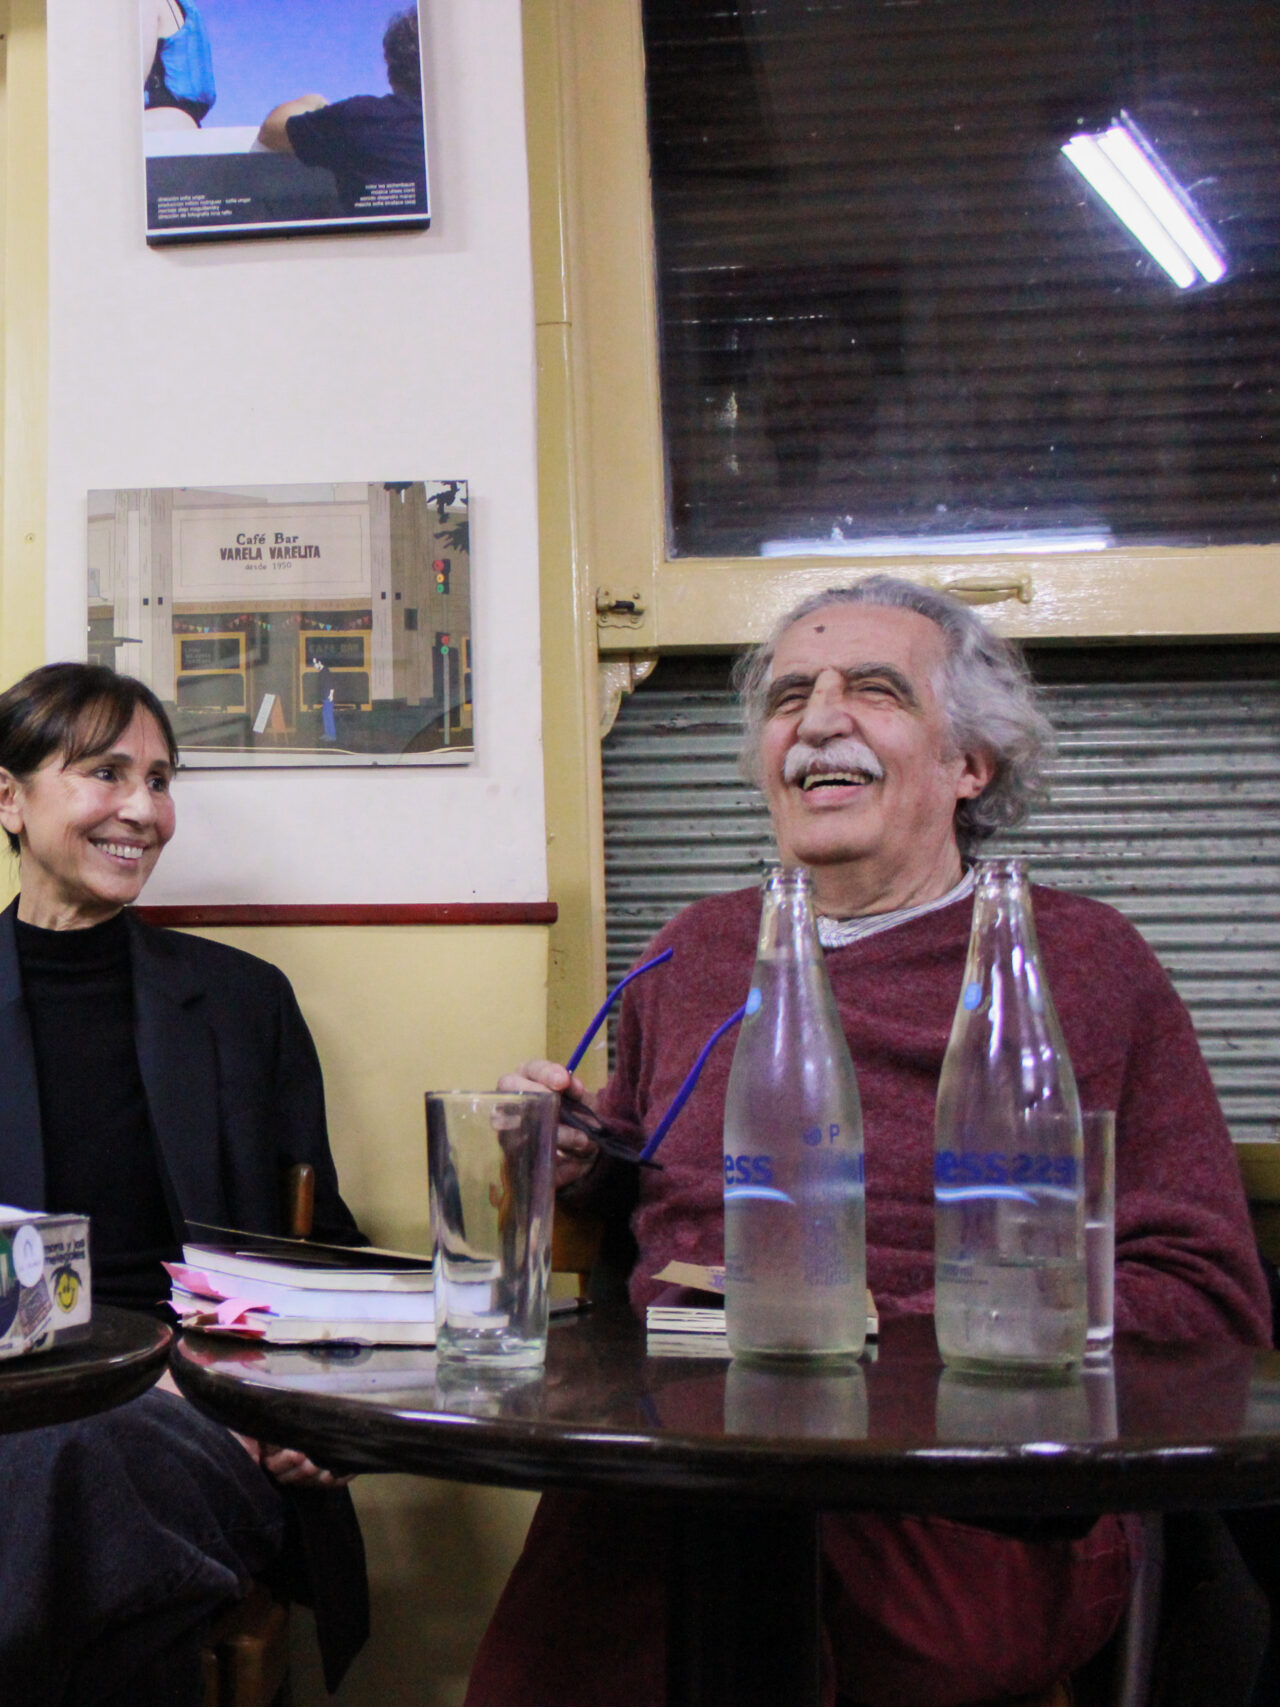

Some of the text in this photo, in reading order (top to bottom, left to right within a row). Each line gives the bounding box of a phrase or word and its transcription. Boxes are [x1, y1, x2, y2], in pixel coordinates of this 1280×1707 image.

[236, 532, 299, 545] Café Bar
[220, 545, 320, 560] VARELA VARELITA
